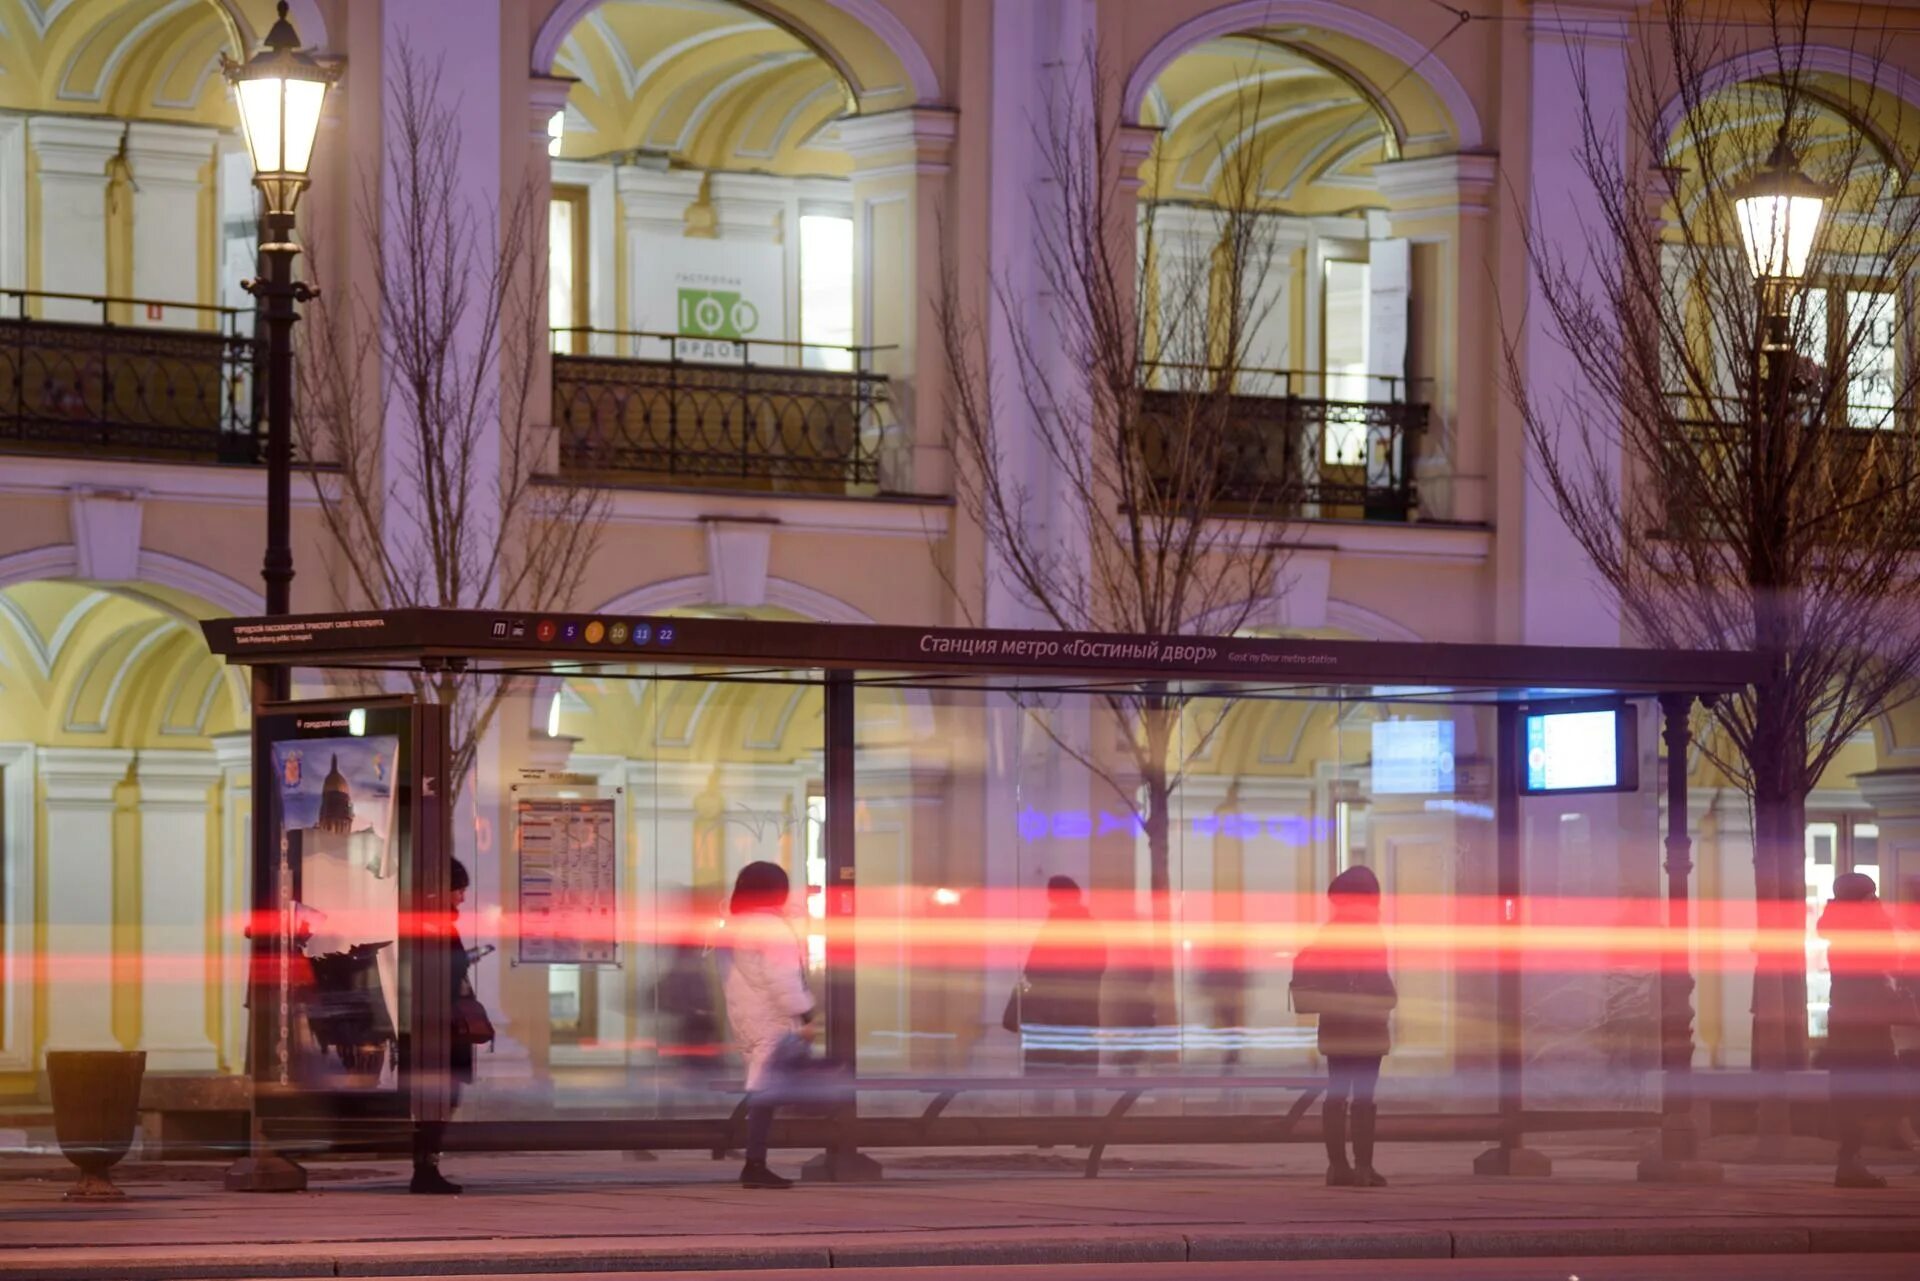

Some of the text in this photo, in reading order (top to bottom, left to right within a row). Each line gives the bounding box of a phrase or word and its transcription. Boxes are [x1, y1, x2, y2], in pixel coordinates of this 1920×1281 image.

[567, 626, 575, 637] 5
[611, 628, 625, 638] 10
[635, 628, 649, 639] 11
[659, 630, 673, 640] 22
[919, 634, 1217, 664] Станция метро «Гостиный двор»
[1281, 653, 1307, 664] metro
[1307, 654, 1338, 665] station
